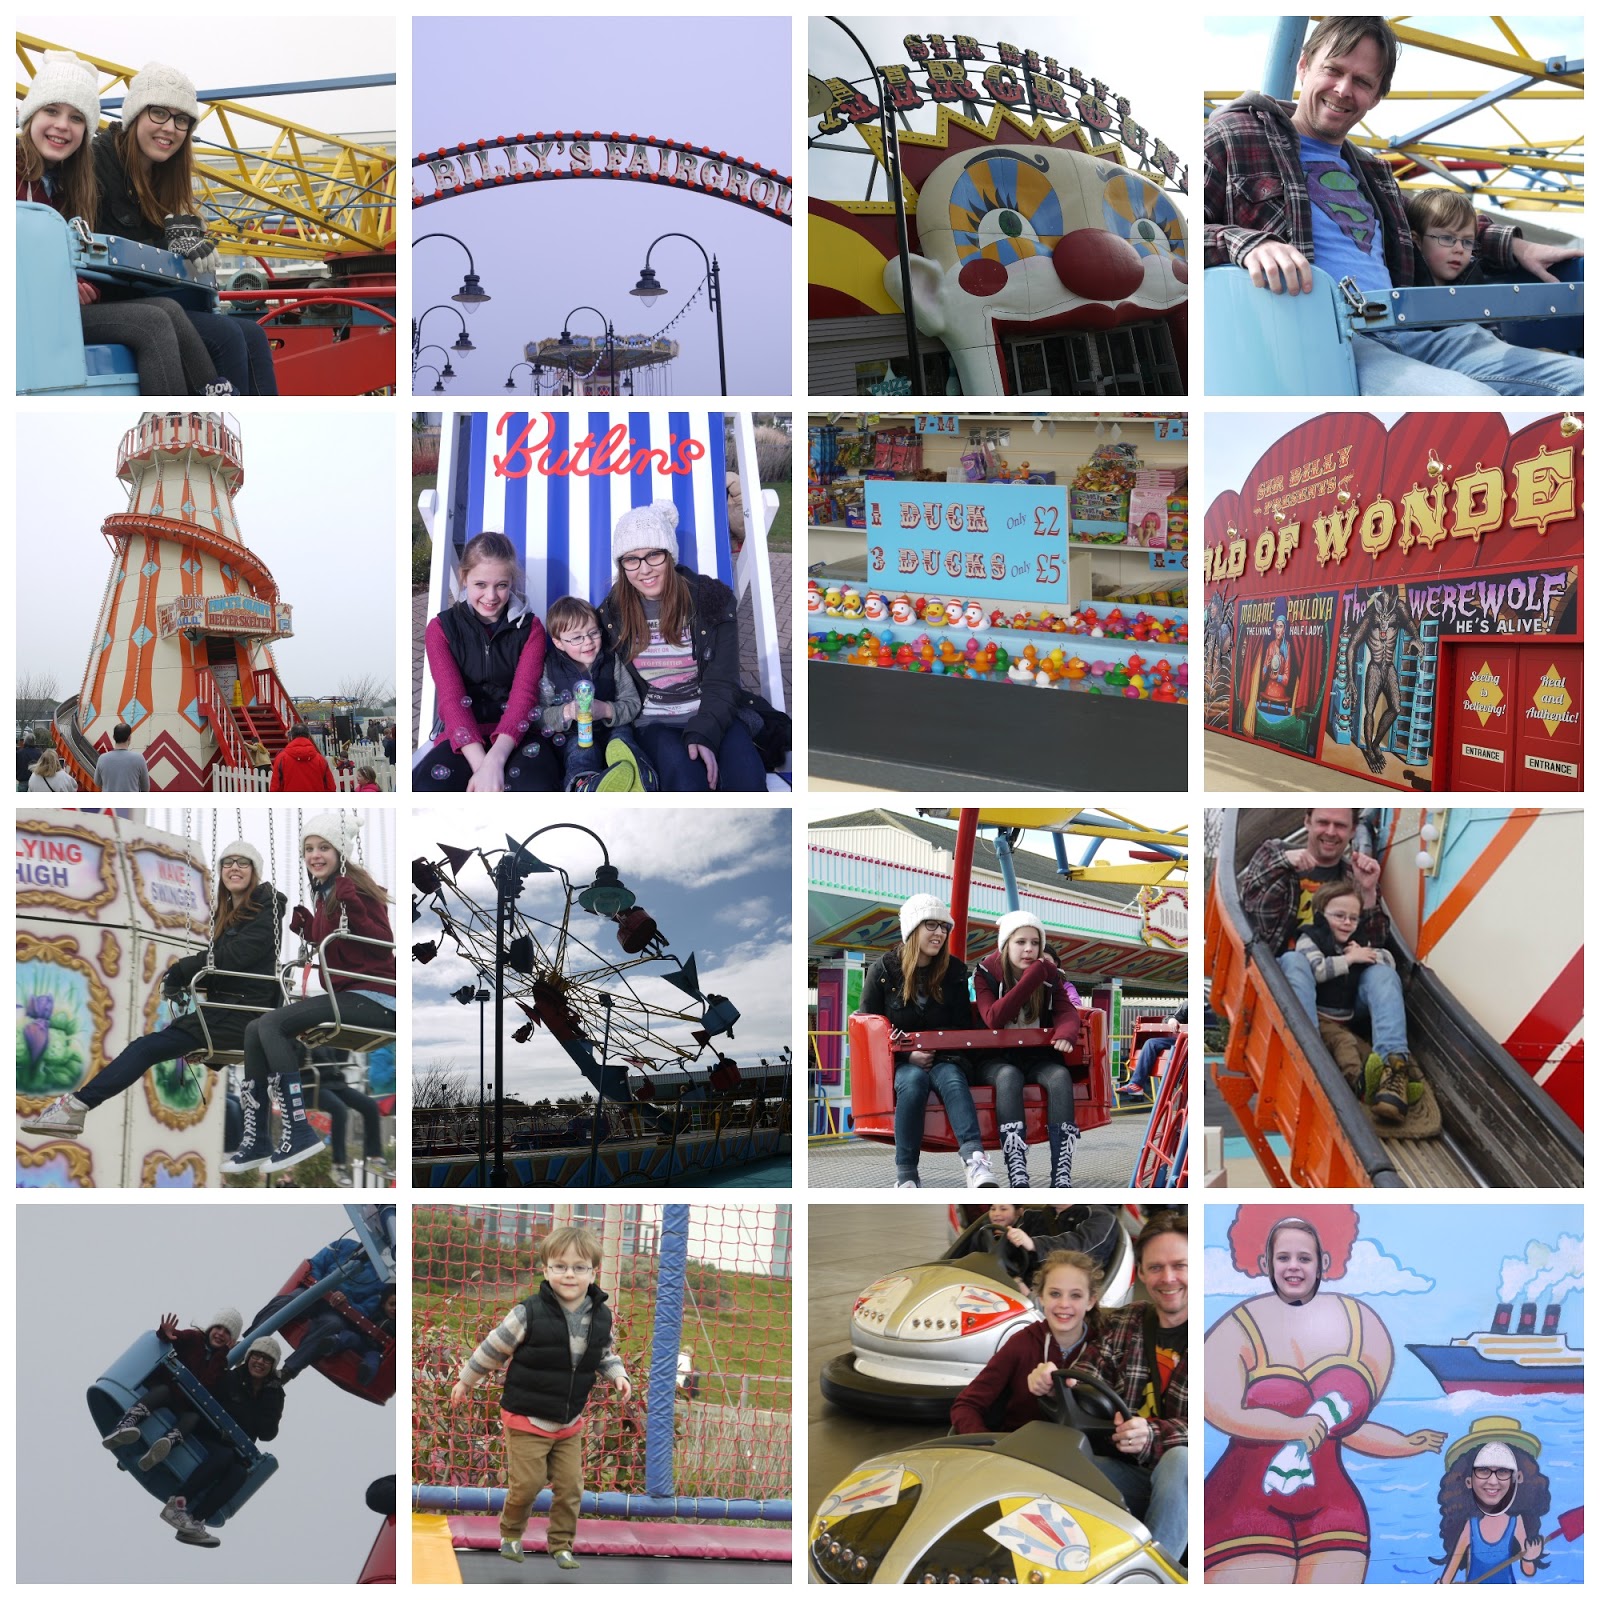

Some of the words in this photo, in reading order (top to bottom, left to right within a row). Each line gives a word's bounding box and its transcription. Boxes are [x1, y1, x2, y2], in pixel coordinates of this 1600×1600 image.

[903, 33, 985, 61] SIR
[997, 41, 1131, 116] BILLY'S
[428, 140, 593, 192] BILLY'S
[871, 376, 910, 395] PRIZE
[493, 412, 705, 479] Butlin's
[1256, 475, 1284, 501] SIR
[1289, 444, 1353, 487] BILLY
[1263, 476, 1337, 516] PRESENTS
[899, 502, 989, 533] DUCK
[1007, 513, 1027, 530] Only
[1033, 506, 1061, 536] £2
[1254, 521, 1301, 577] OF
[1312, 444, 1584, 568] WONDE
[871, 546, 886, 573] 3
[898, 548, 1007, 580] DUCKS
[1011, 560, 1031, 578] Only
[1036, 554, 1061, 584] £5
[1342, 584, 1367, 624] The
[1408, 572, 1569, 624] WEREWOLF
[1241, 602, 1275, 625] MADAME
[1287, 597, 1334, 622] PAVLOVA
[209, 613, 239, 627] HELTER
[240, 615, 272, 629] SKELTER
[1456, 618, 1489, 633] HE'S
[1496, 616, 1554, 633] ALIVE!
[1246, 627, 1255, 635] THE
[1255, 627, 1272, 635] LIVING
[1289, 626, 1304, 635] HALF
[1305, 625, 1324, 637] LADY!
[1470, 671, 1500, 685] Seeing
[1540, 675, 1566, 688] Real
[1480, 688, 1488, 697] is
[1541, 693, 1564, 705] and
[1463, 699, 1506, 717] Believing!
[1525, 706, 1579, 723] Authentic!
[1465, 746, 1500, 760] ENTRANCE
[1529, 758, 1572, 774] ENTRANCE
[157, 860, 187, 885] WAVE
